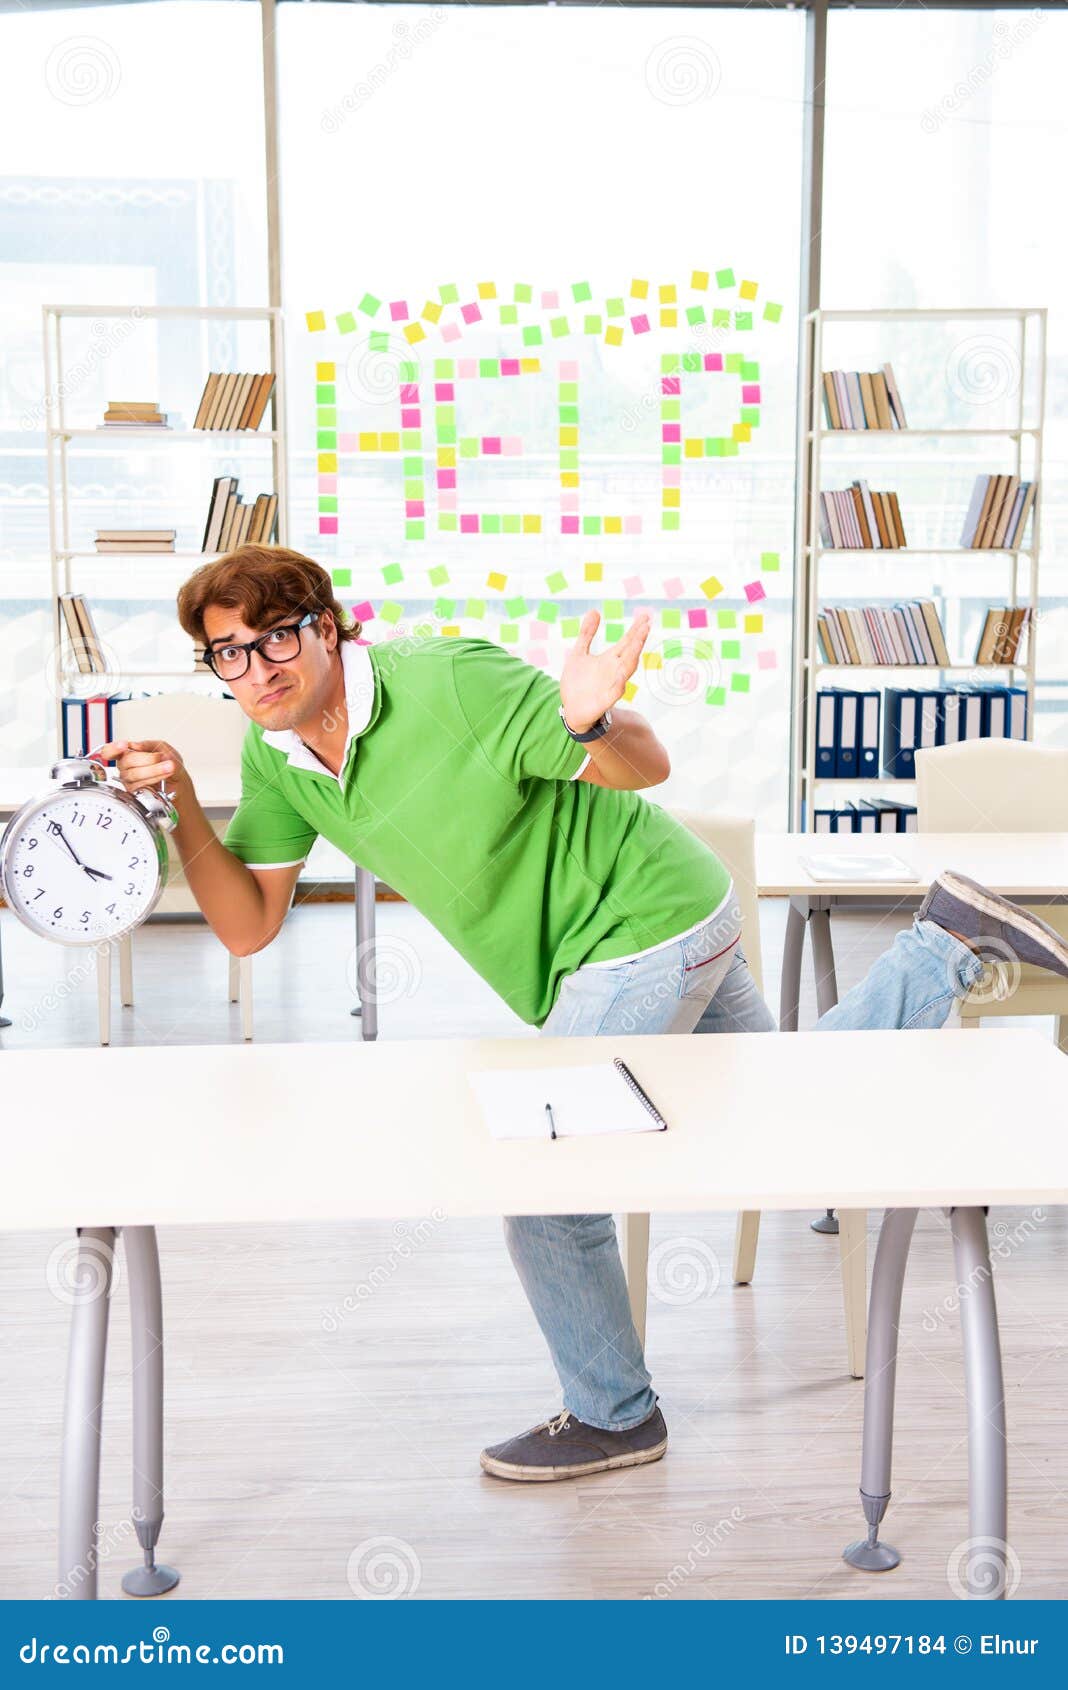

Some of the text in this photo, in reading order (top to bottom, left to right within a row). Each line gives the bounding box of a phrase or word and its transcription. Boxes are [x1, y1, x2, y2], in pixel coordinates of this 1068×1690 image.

[316, 353, 761, 540] HELP
[71, 811, 86, 827] 11
[96, 813, 113, 830] 12
[46, 820, 63, 836] 10
[28, 838, 39, 850] 9
[121, 832, 129, 845] 1
[128, 856, 139, 870] 2
[23, 864, 34, 878] 8
[33, 888, 46, 901] 7
[124, 882, 136, 896] 3
[53, 906, 63, 919] 6
[105, 902, 117, 915] 4
[80, 911, 92, 924] 5
